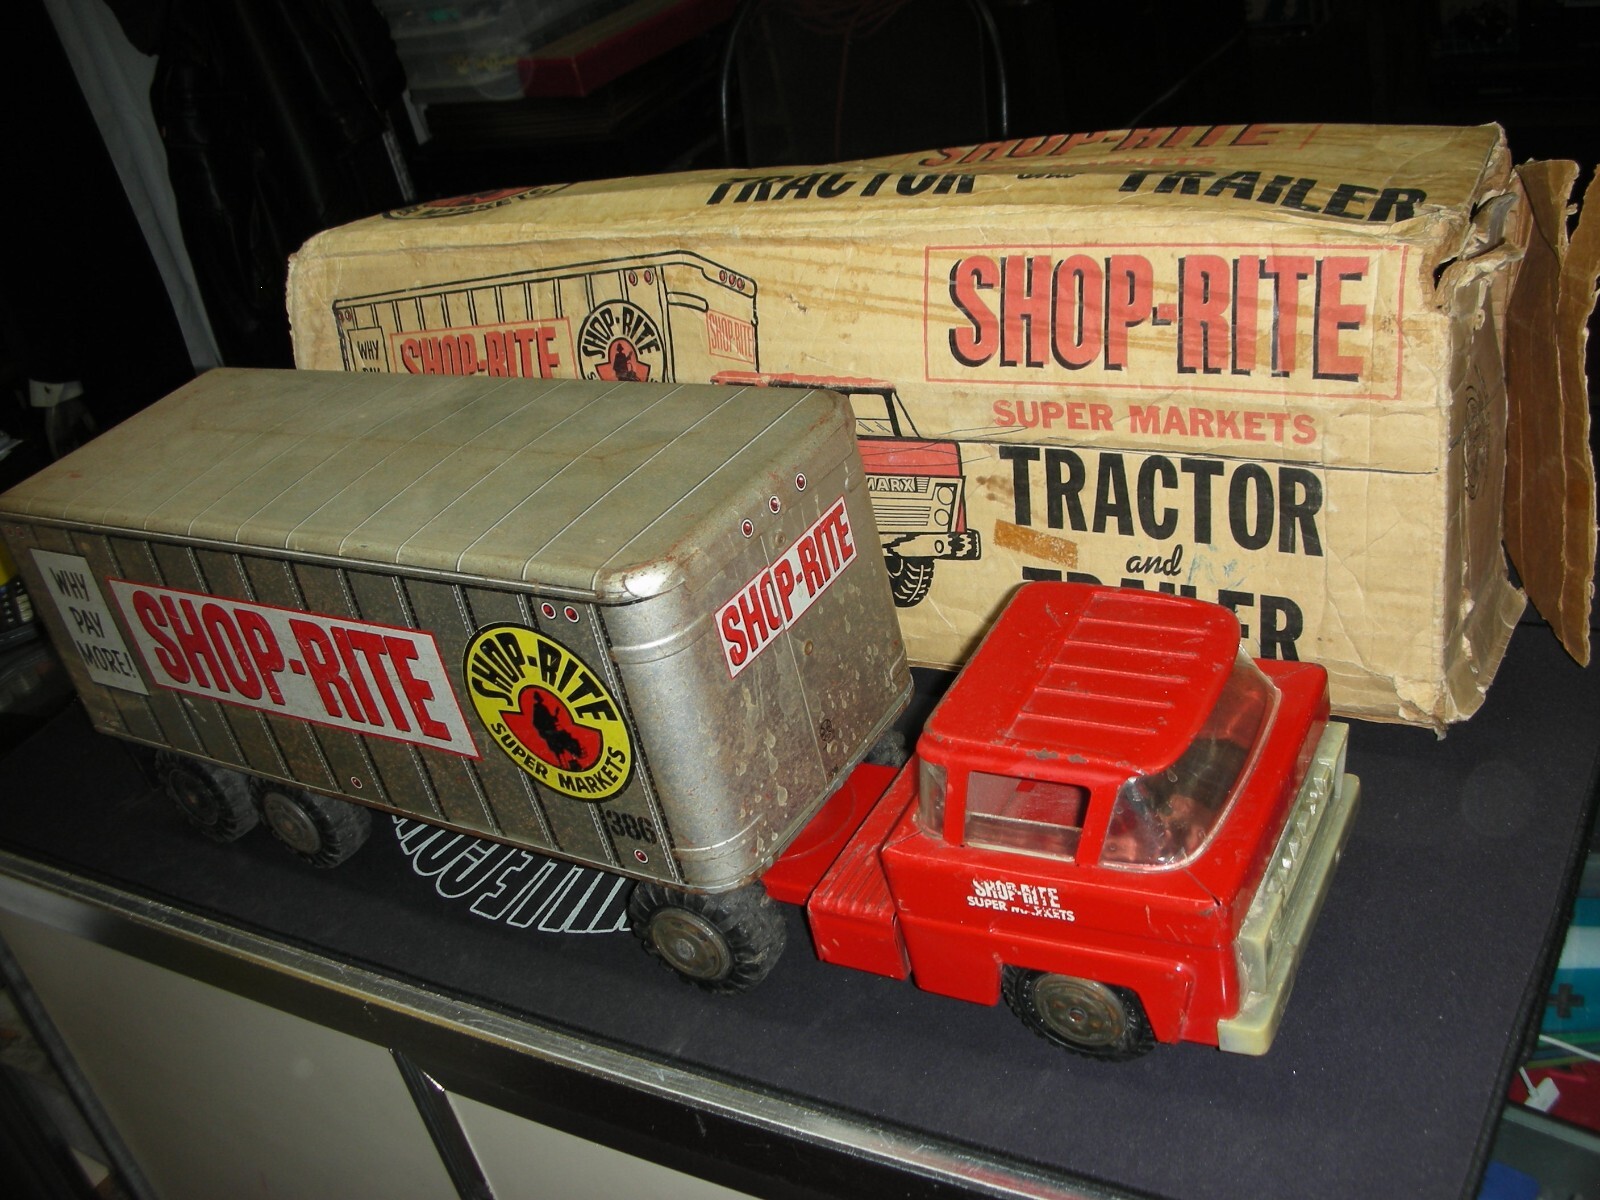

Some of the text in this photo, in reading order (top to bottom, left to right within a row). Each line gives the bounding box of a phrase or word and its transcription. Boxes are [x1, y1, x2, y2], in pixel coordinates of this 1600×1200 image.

[1119, 170, 1427, 222] TRAILER
[582, 306, 661, 359] SHOP-RITE
[949, 254, 1369, 382] SHOP-RITE
[357, 339, 379, 360] WHY
[401, 326, 562, 379] SHOP-RITE
[992, 400, 1318, 445] SUPER MARKETS
[999, 445, 1325, 558] TRACTOR
[48, 566, 90, 602] WHY
[1126, 544, 1183, 576] and
[721, 504, 854, 667] SHOP-RITE
[68, 606, 105, 639] PAY
[76, 640, 137, 679] MORE!
[132, 590, 453, 741] SHOP-RITE
[471, 632, 619, 722] SHOP-RITE
[489, 721, 627, 794] SUPER MARKETS
[605, 809, 658, 844] 386
[966, 895, 1008, 912] SUPER
[972, 879, 1061, 909] SHOP-RITE
